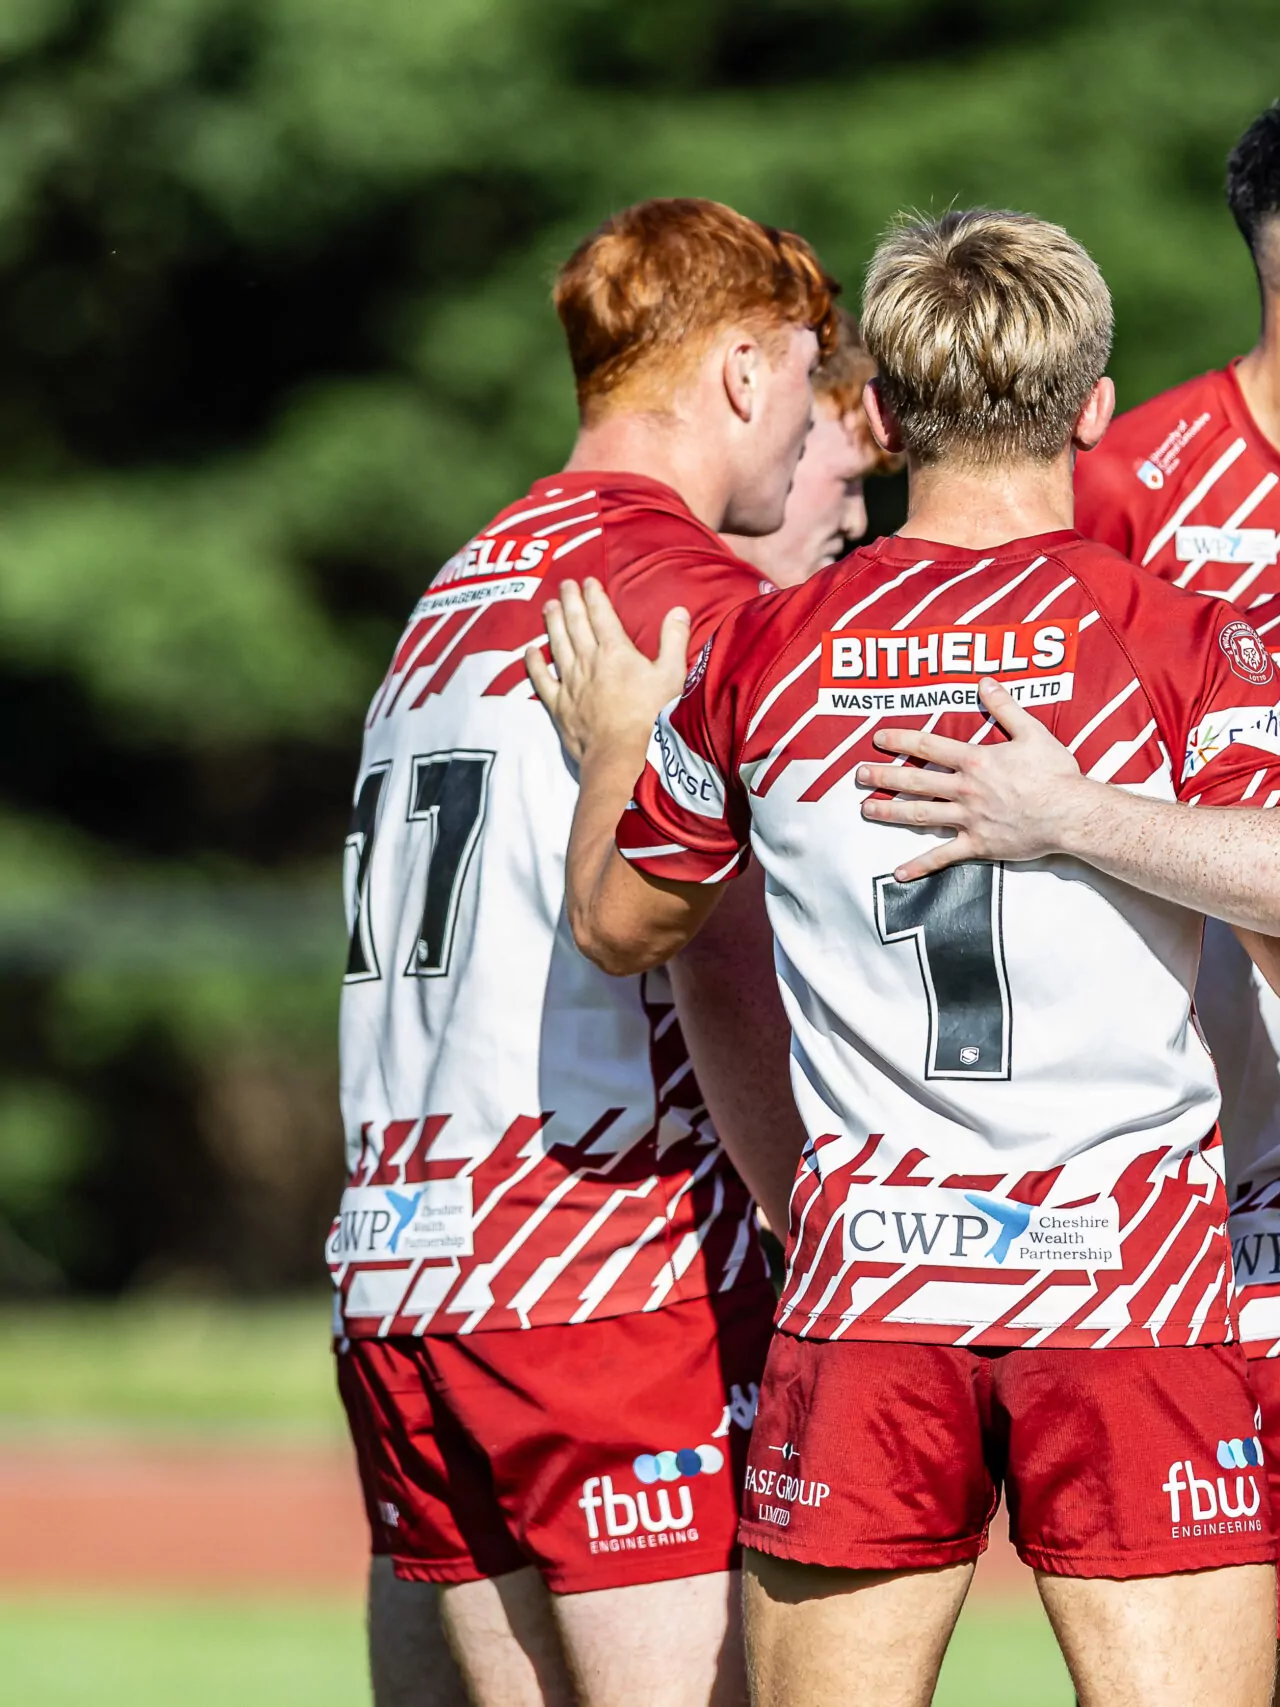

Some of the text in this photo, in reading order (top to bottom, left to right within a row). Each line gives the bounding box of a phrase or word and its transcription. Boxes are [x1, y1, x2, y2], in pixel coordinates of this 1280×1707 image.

[831, 626, 1066, 679] BITHELLS
[1249, 674, 1267, 682] LOTTO
[832, 681, 1061, 710] WASTE MANAGET LTD
[654, 720, 713, 801] hurst
[872, 860, 1013, 1081] 1
[849, 1209, 989, 1257] CWP
[1039, 1216, 1110, 1229] Cheshire
[1029, 1231, 1085, 1245] Wealth
[1019, 1247, 1113, 1263] Partnership
[744, 1465, 831, 1507] FASE GROUP
[1162, 1460, 1260, 1523] fbw
[578, 1475, 694, 1539] fbw
[758, 1503, 790, 1527] LIMITED
[590, 1528, 700, 1555] ENGINEERING
[1171, 1520, 1262, 1539] ENGINEERING
